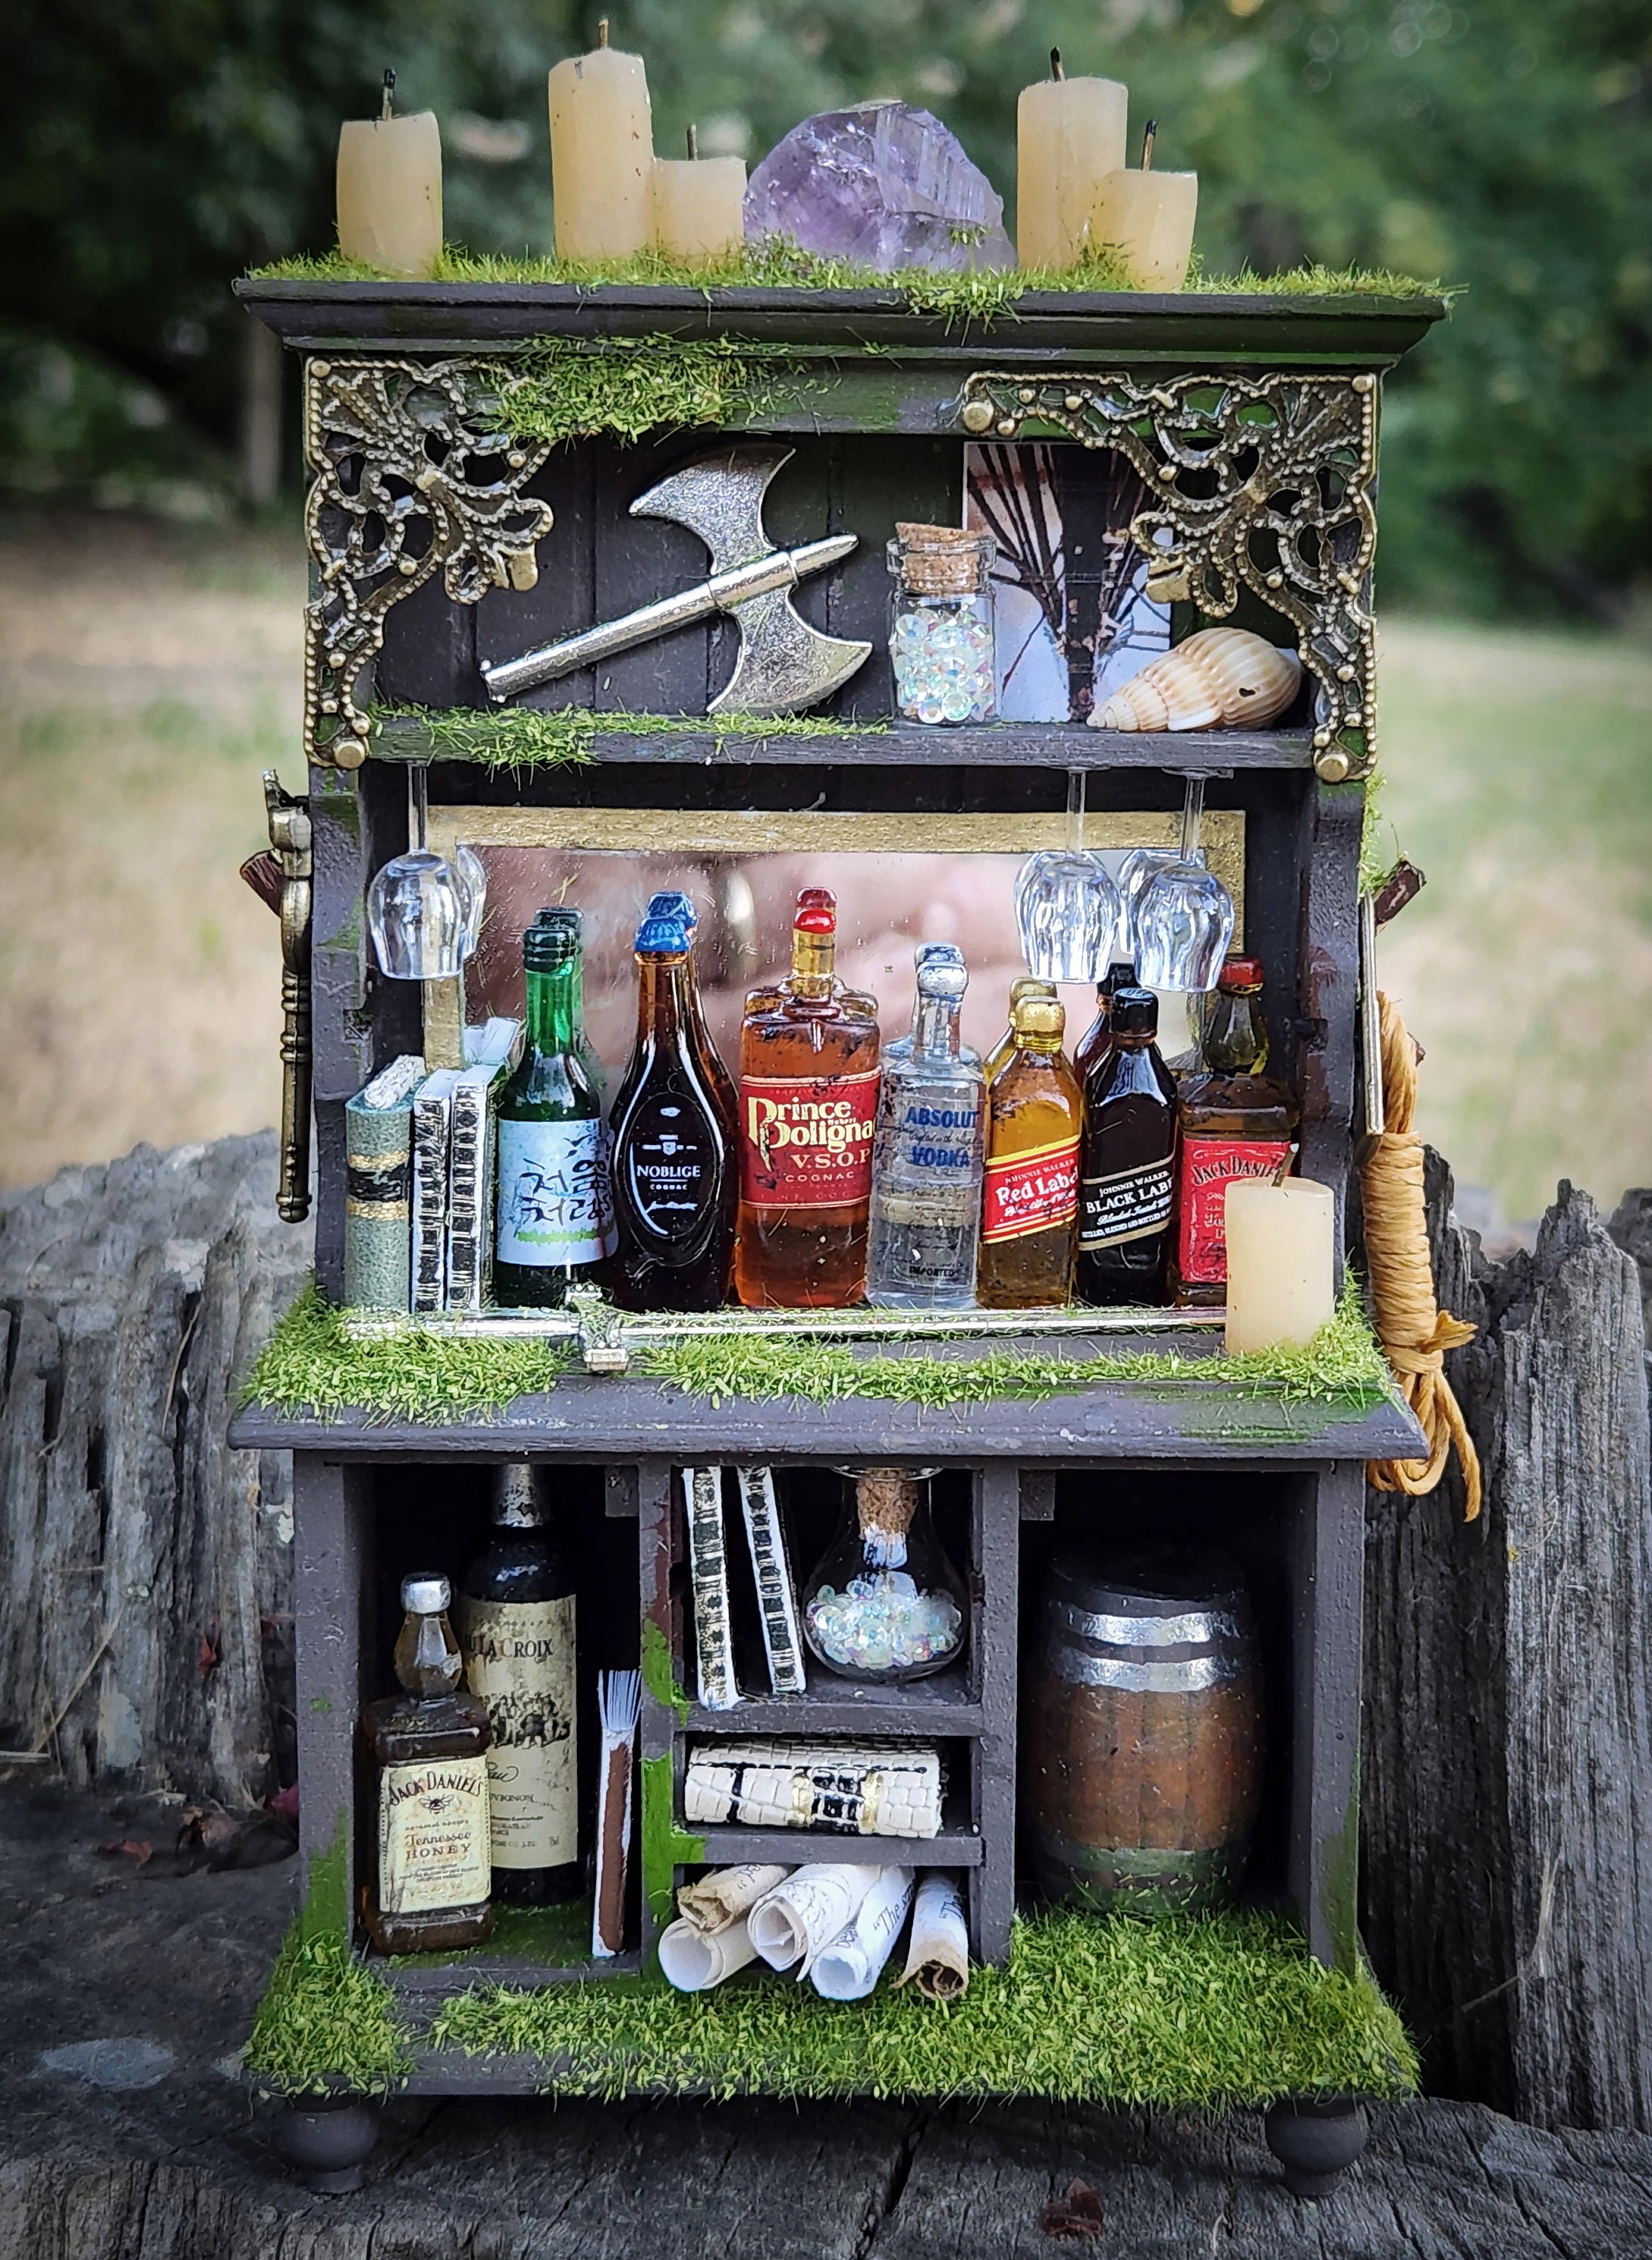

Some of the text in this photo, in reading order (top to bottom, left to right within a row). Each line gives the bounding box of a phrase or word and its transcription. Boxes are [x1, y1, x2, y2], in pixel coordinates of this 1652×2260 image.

[748, 1096, 852, 1139] Prince
[904, 1106, 981, 1128] ABSOLUT
[912, 1145, 970, 1168] VODKA
[637, 1165, 701, 1177] NOBLIGE
[784, 1171, 855, 1183] COGNAC
[1190, 1159, 1230, 1186] JACK
[994, 1180, 1036, 1207] Red
[1086, 1191, 1137, 1214] BLACK
[388, 1777, 426, 1807] JACK
[405, 1831, 472, 1848] Tennessee
[405, 1842, 472, 1863] HONEY
